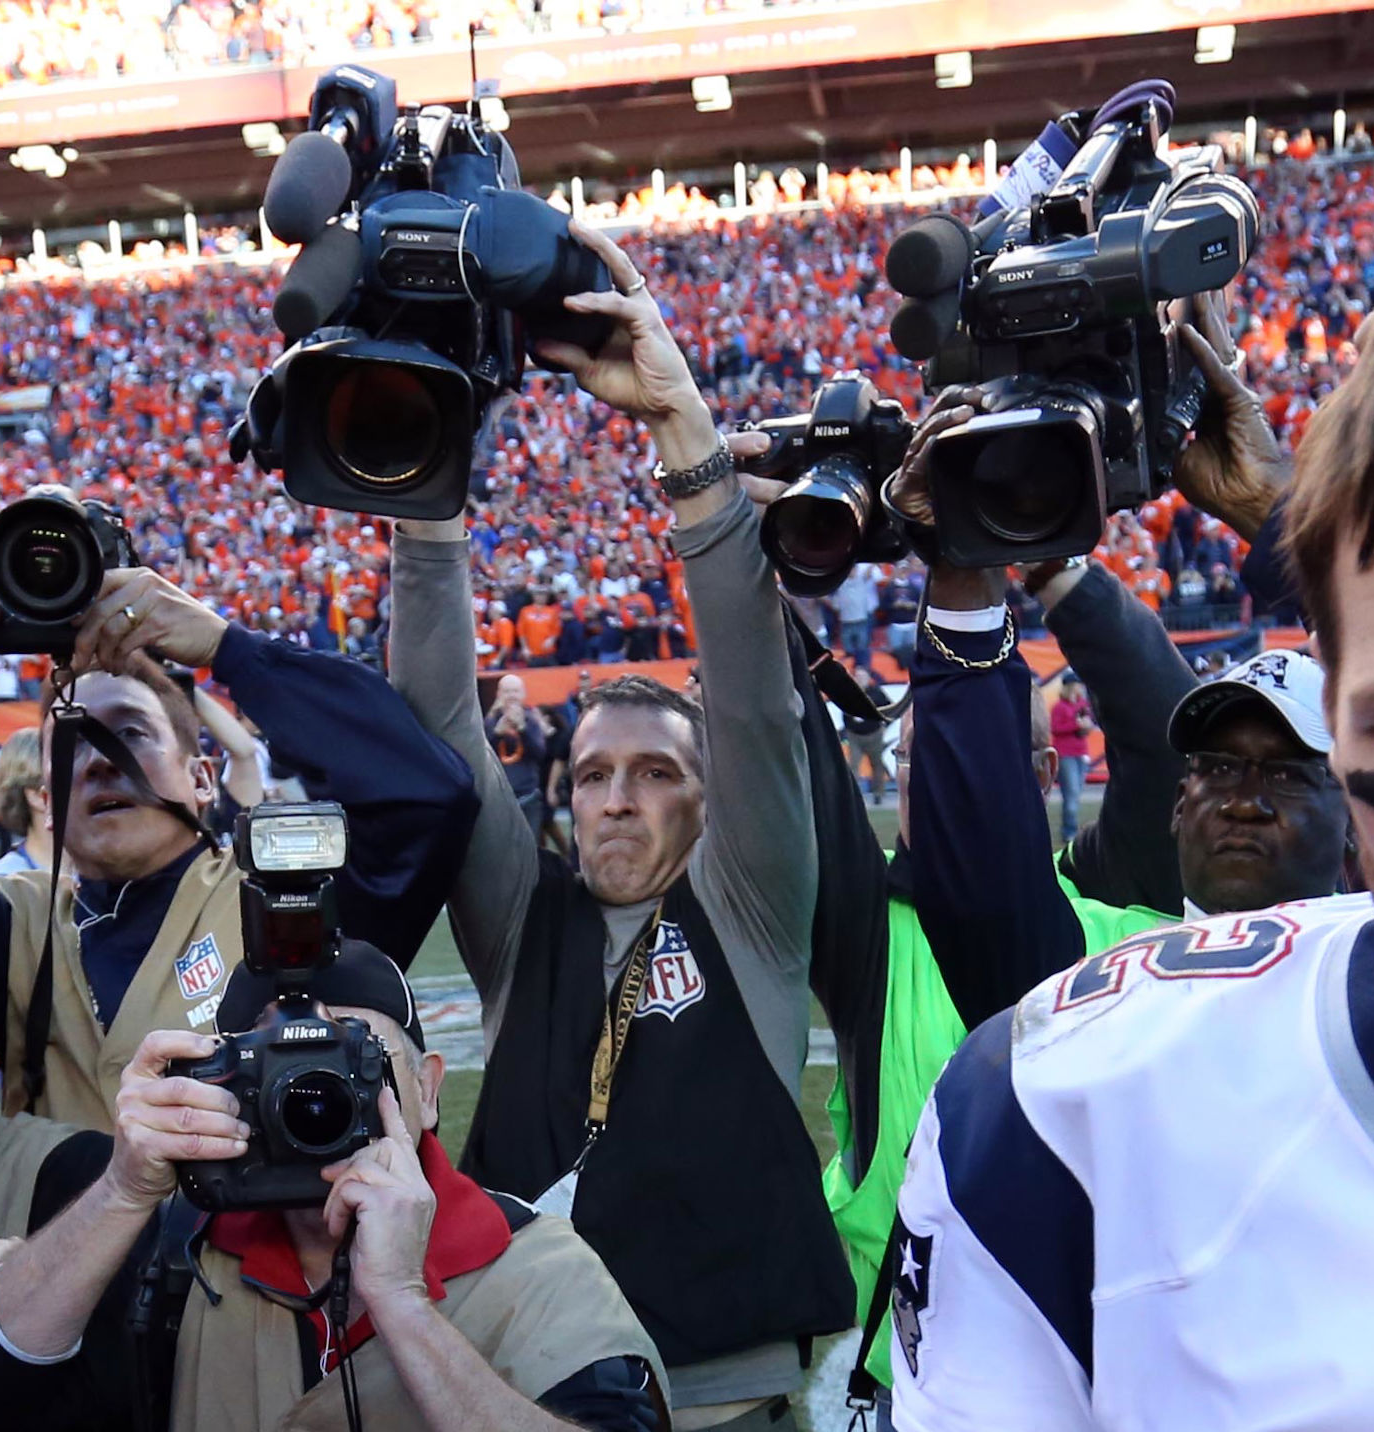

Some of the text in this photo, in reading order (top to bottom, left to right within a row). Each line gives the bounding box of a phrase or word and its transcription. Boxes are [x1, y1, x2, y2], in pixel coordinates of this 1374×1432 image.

[397, 232, 431, 243] SONY
[998, 269, 1035, 283] SONY
[814, 425, 850, 438] Nikon
[280, 894, 309, 902] Nikon
[182, 957, 219, 993] NFL
[283, 1026, 328, 1040] Nikon
[240, 1050, 255, 1060] D4
